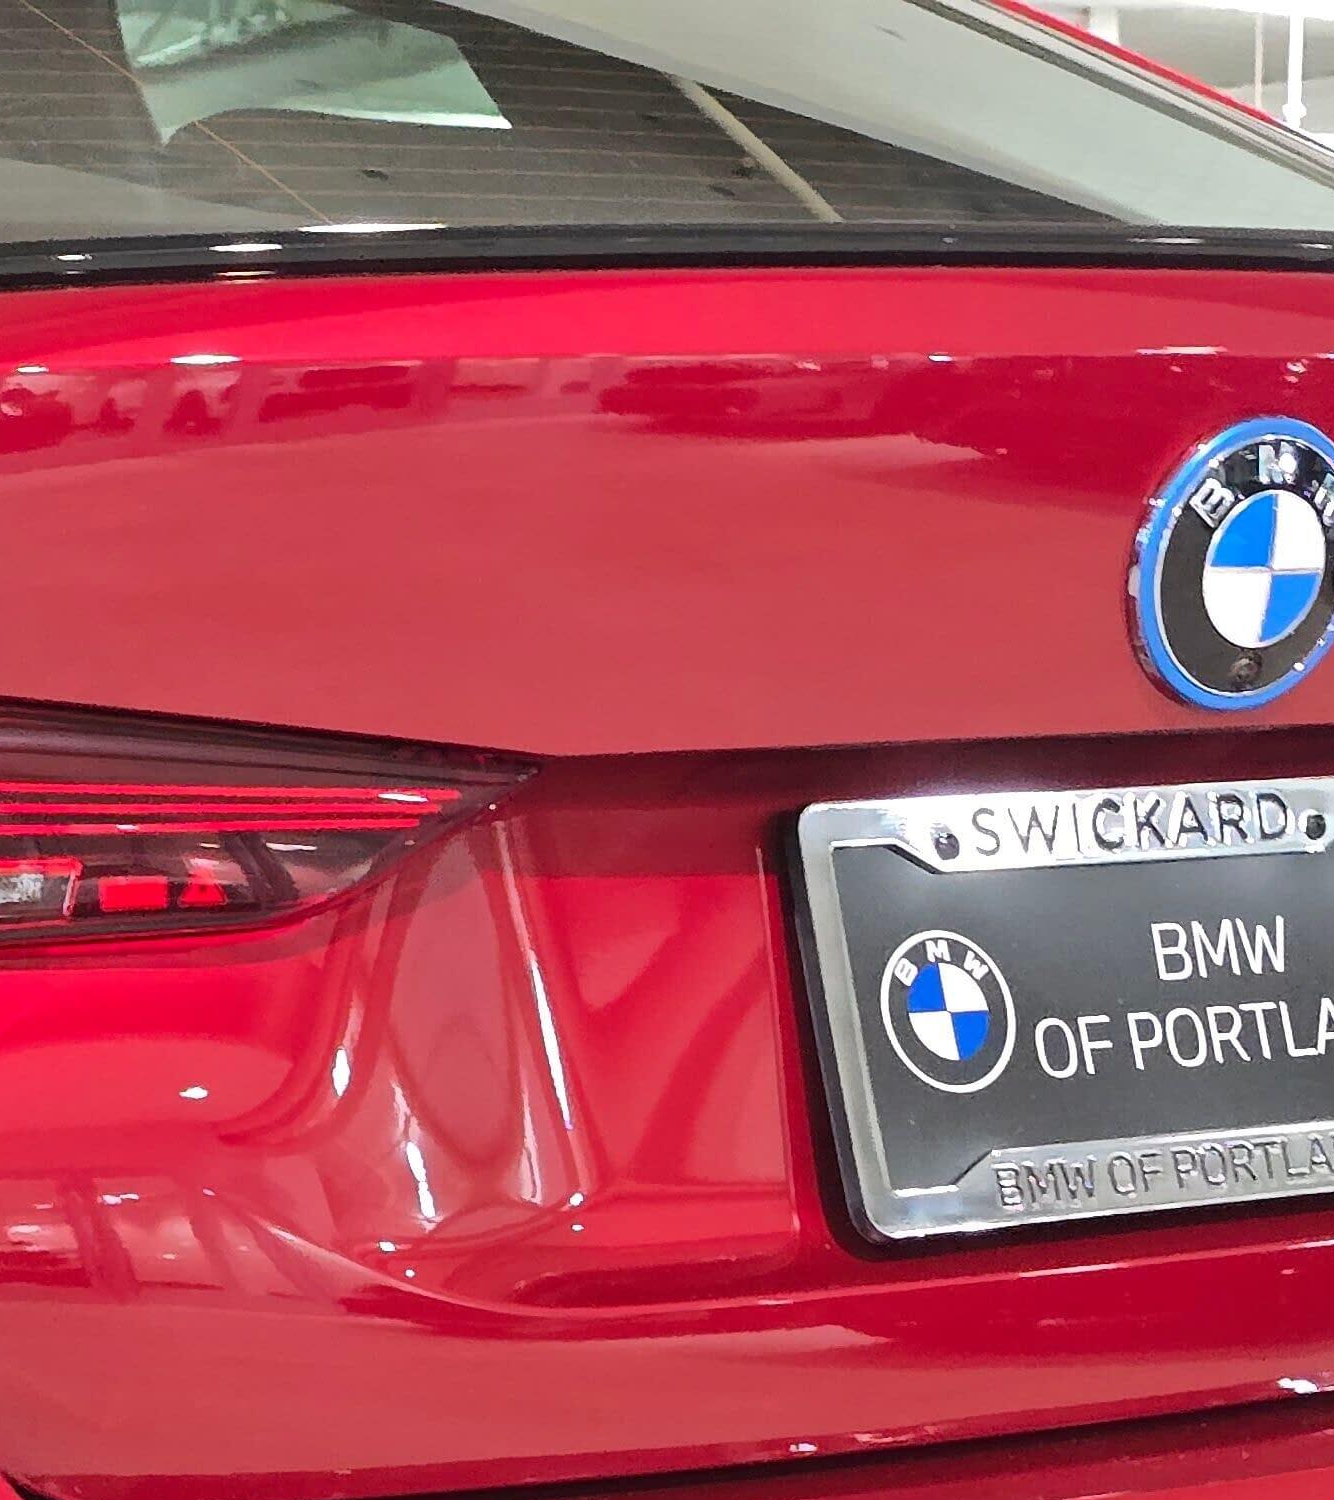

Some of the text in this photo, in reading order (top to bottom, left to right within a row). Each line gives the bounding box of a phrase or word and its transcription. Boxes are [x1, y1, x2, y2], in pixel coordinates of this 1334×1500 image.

[971, 791, 1291, 858] SWICKARD
[895, 937, 989, 987] BMW
[1151, 915, 1287, 983] BMW
[1035, 1014, 1114, 1080] OF
[994, 1154, 1096, 1211] BMW
[1110, 1145, 1163, 1199] OF
